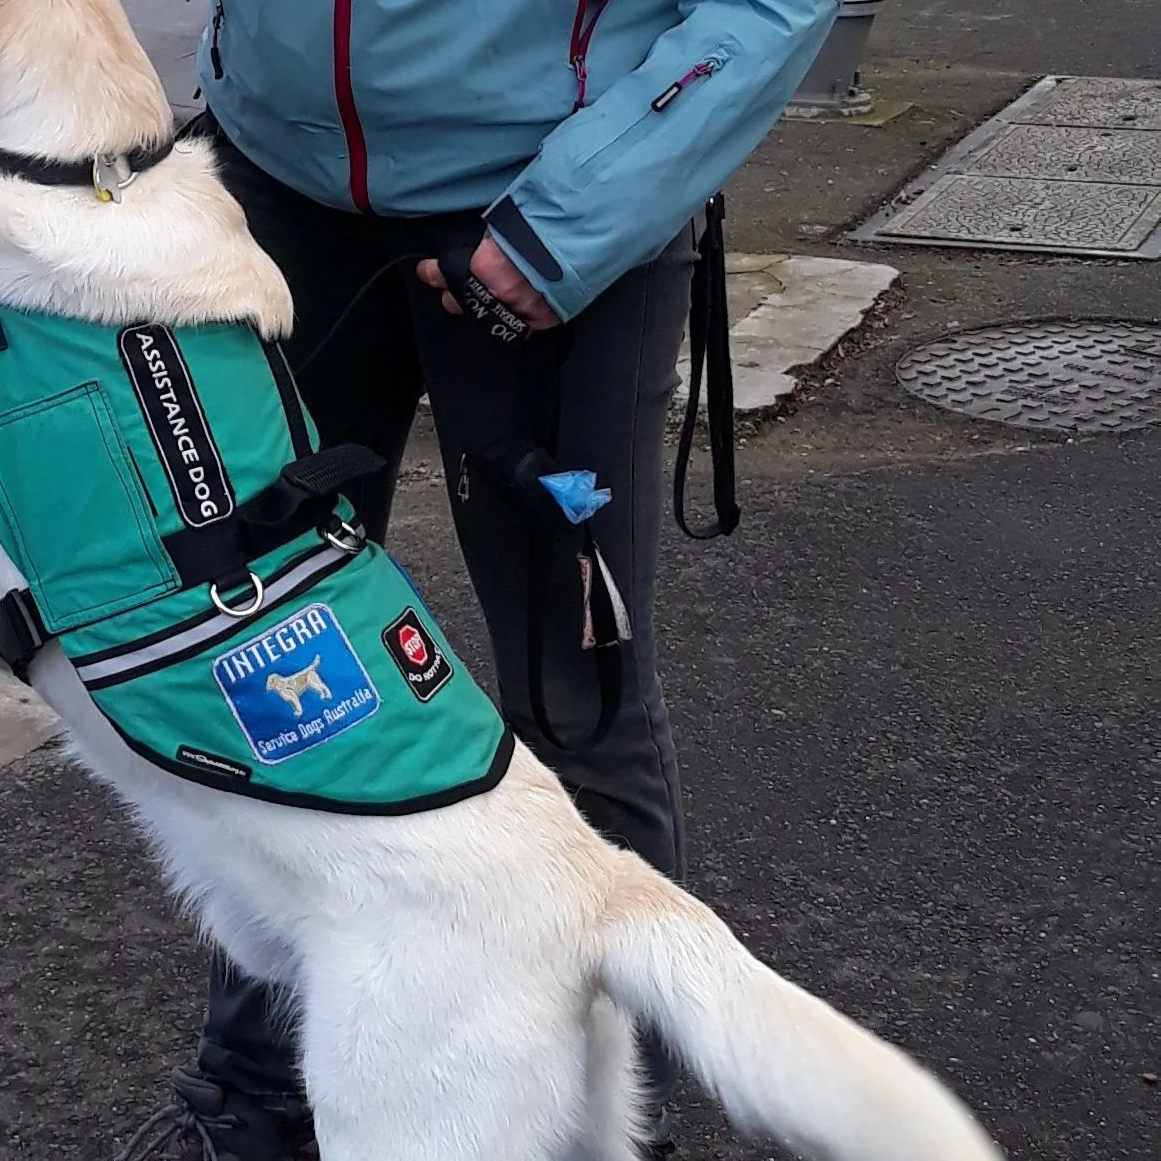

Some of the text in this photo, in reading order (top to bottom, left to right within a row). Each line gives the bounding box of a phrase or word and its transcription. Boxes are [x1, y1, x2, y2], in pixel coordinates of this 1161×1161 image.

[136, 332, 219, 518] ASSISTANCE DOG
[223, 609, 327, 683] INTEGRA
[257, 688, 373, 754] Service Dogs Australia
